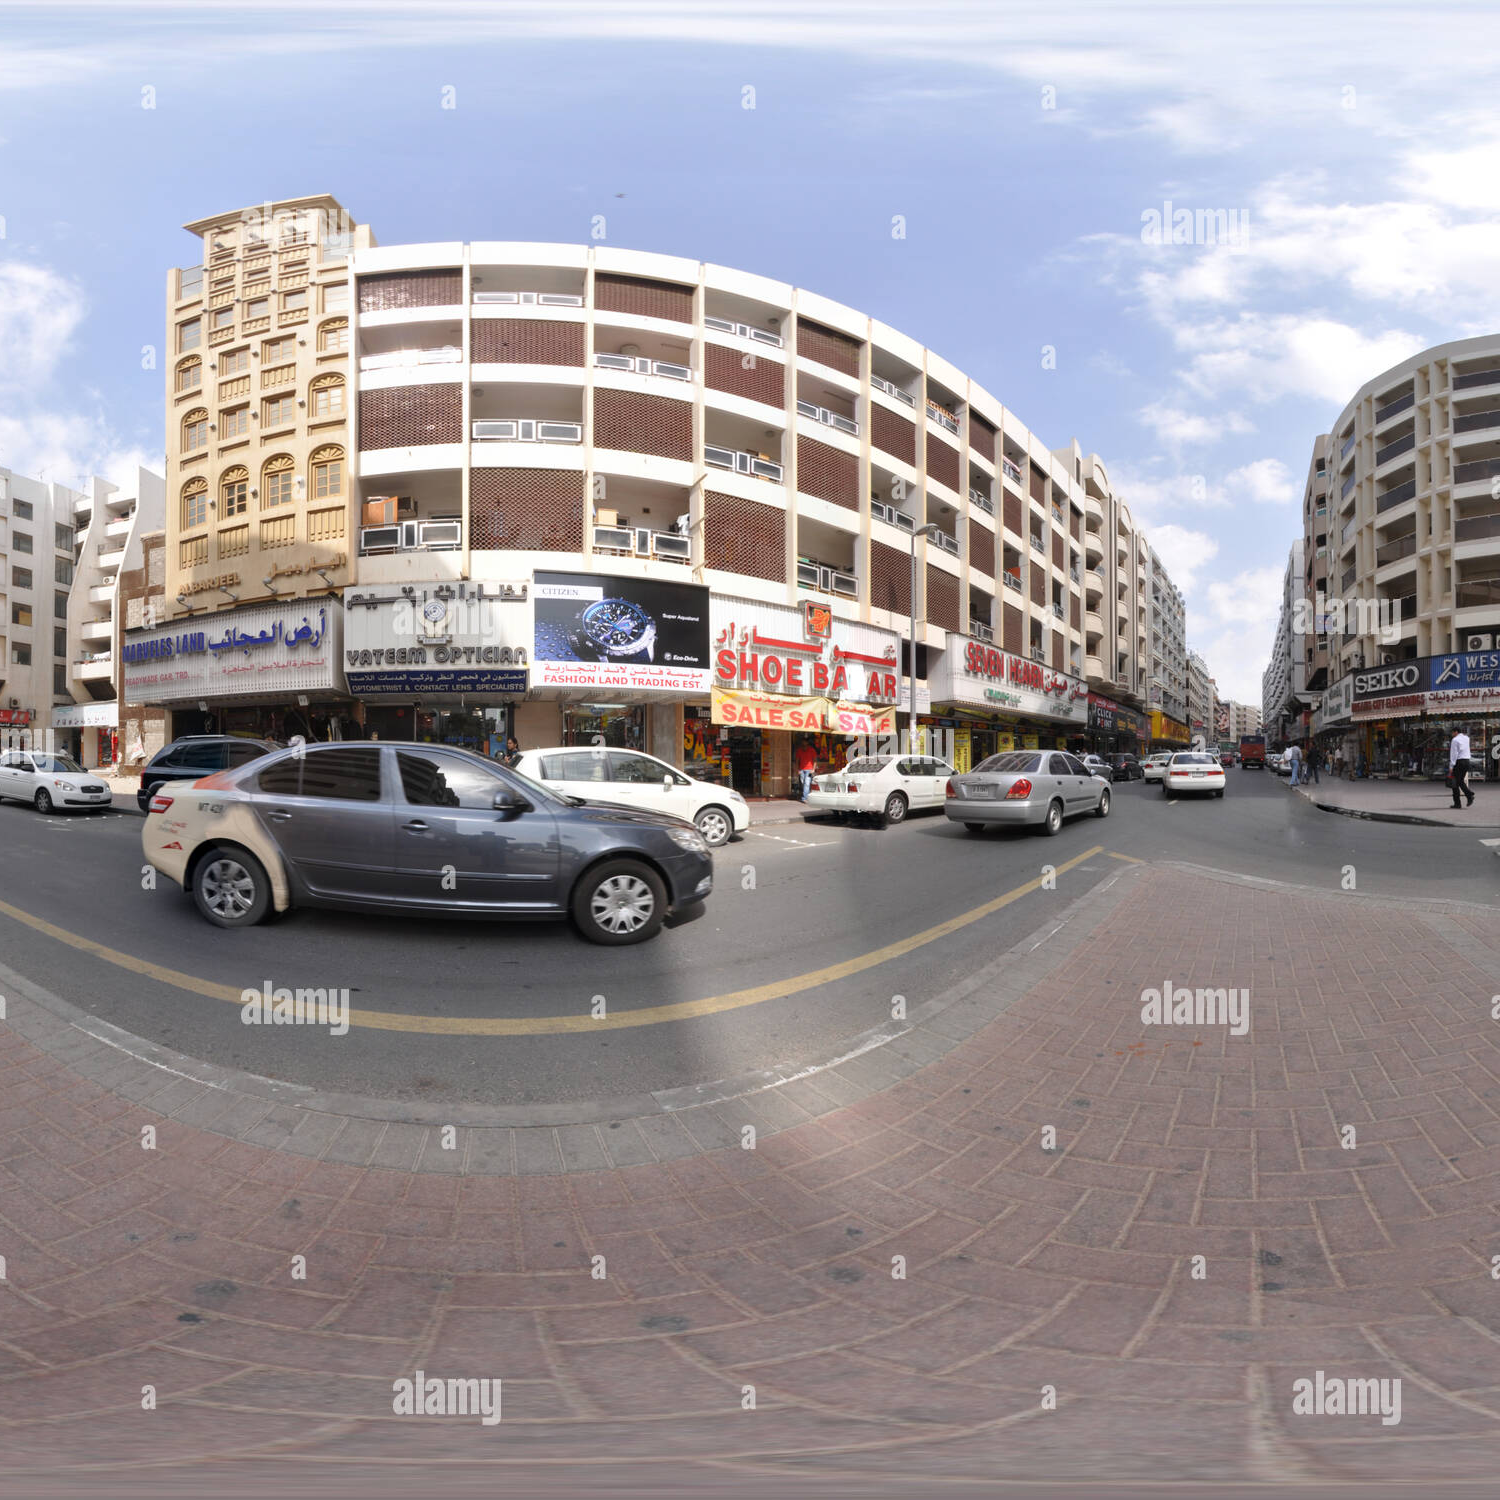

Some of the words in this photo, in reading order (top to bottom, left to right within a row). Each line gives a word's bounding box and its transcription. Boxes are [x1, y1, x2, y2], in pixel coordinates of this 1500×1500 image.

[179, 571, 241, 596] ALBARJEEL
[542, 587, 579, 596] CITIZEN
[208, 620, 283, 657] العجائب
[285, 608, 325, 648] أرض
[176, 632, 204, 654] LAND
[347, 646, 427, 666] YATEEM
[433, 646, 528, 665] OPTICIAN
[967, 641, 1005, 678] SEVEN
[1008, 656, 1045, 690] HEAVEN
[544, 674, 596, 684] FASHION
[599, 675, 629, 685] LAND
[631, 677, 680, 688] TRADING
[682, 679, 703, 689] EST.
[717, 649, 803, 687] SHOE
[814, 662, 897, 698] BAAR
[1355, 665, 1420, 694] SEIKO
[722, 703, 785, 726] SALE
[1097, 708, 1112, 719] CLICK
